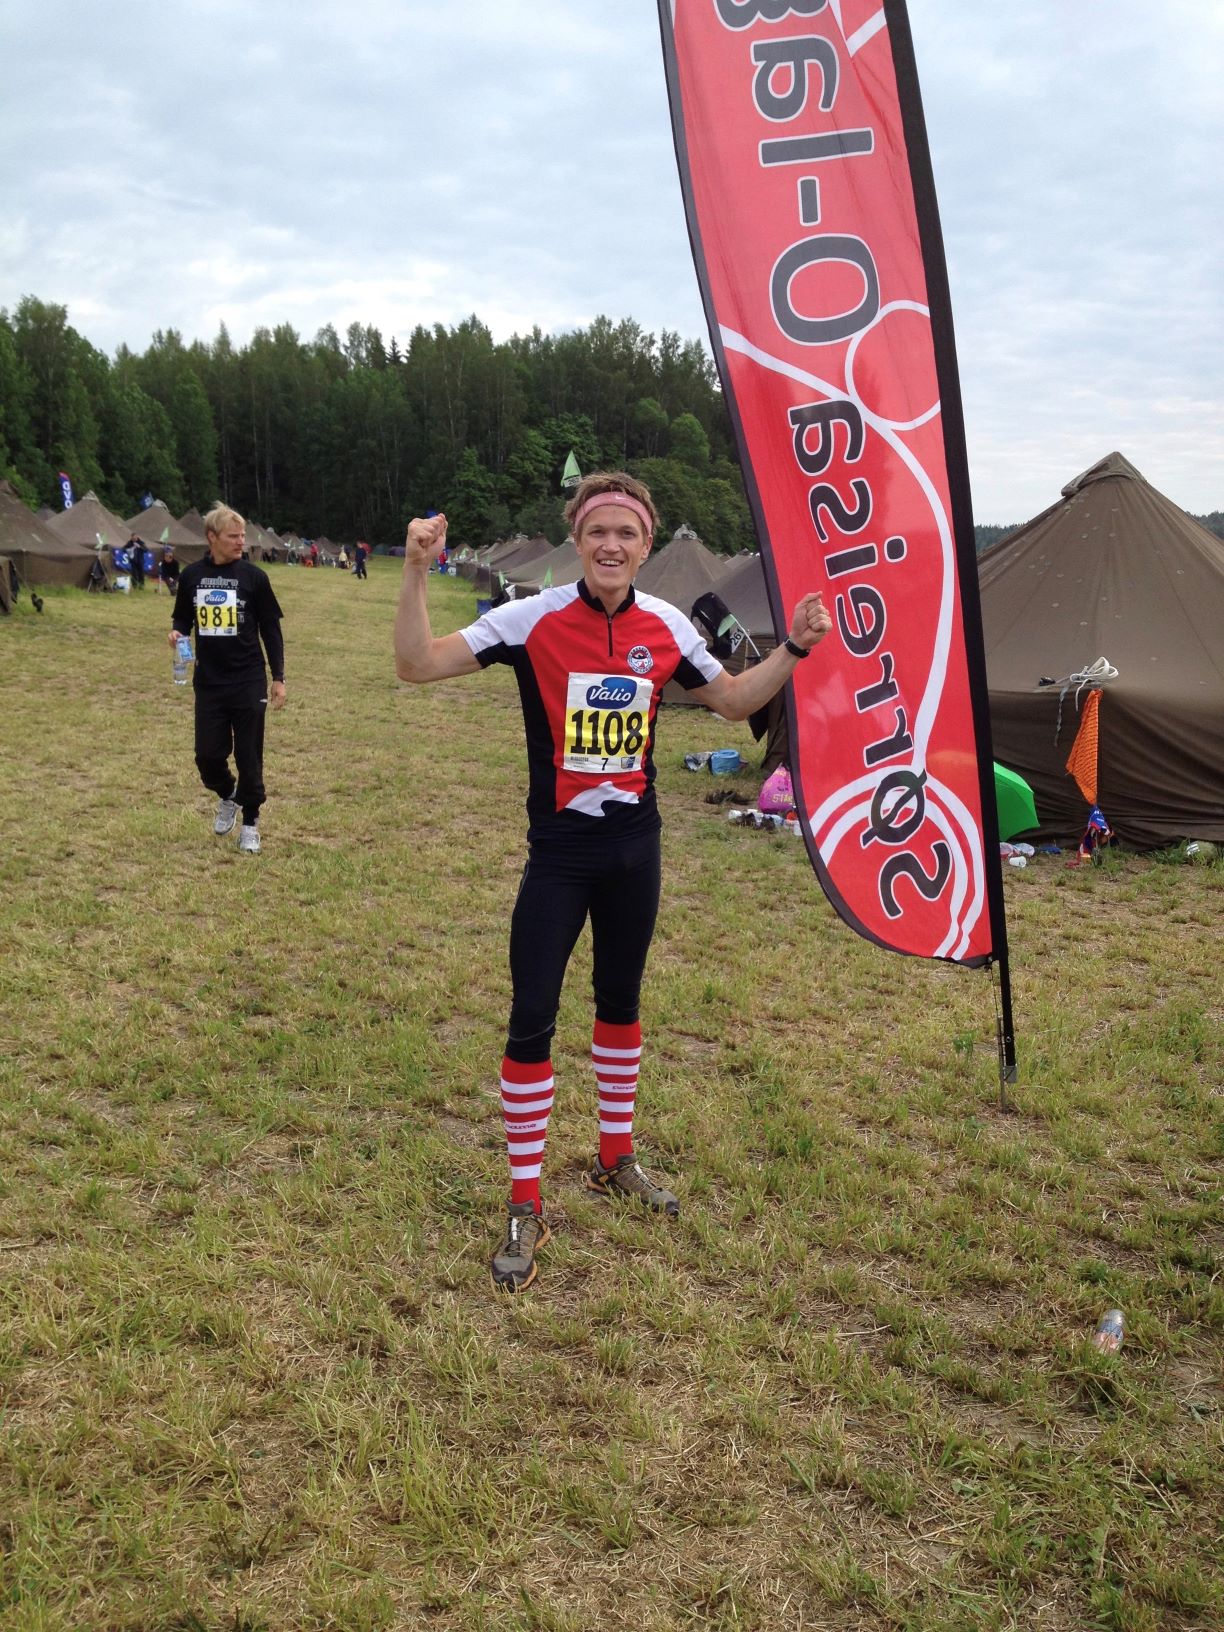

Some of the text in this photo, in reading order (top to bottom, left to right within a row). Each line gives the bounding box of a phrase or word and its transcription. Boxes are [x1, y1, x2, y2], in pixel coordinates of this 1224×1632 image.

[205, 593, 226, 602] Valio
[200, 606, 235, 627] 981
[588, 686, 632, 702] Valio
[570, 709, 643, 756] 1108
[601, 757, 609, 771] 7
